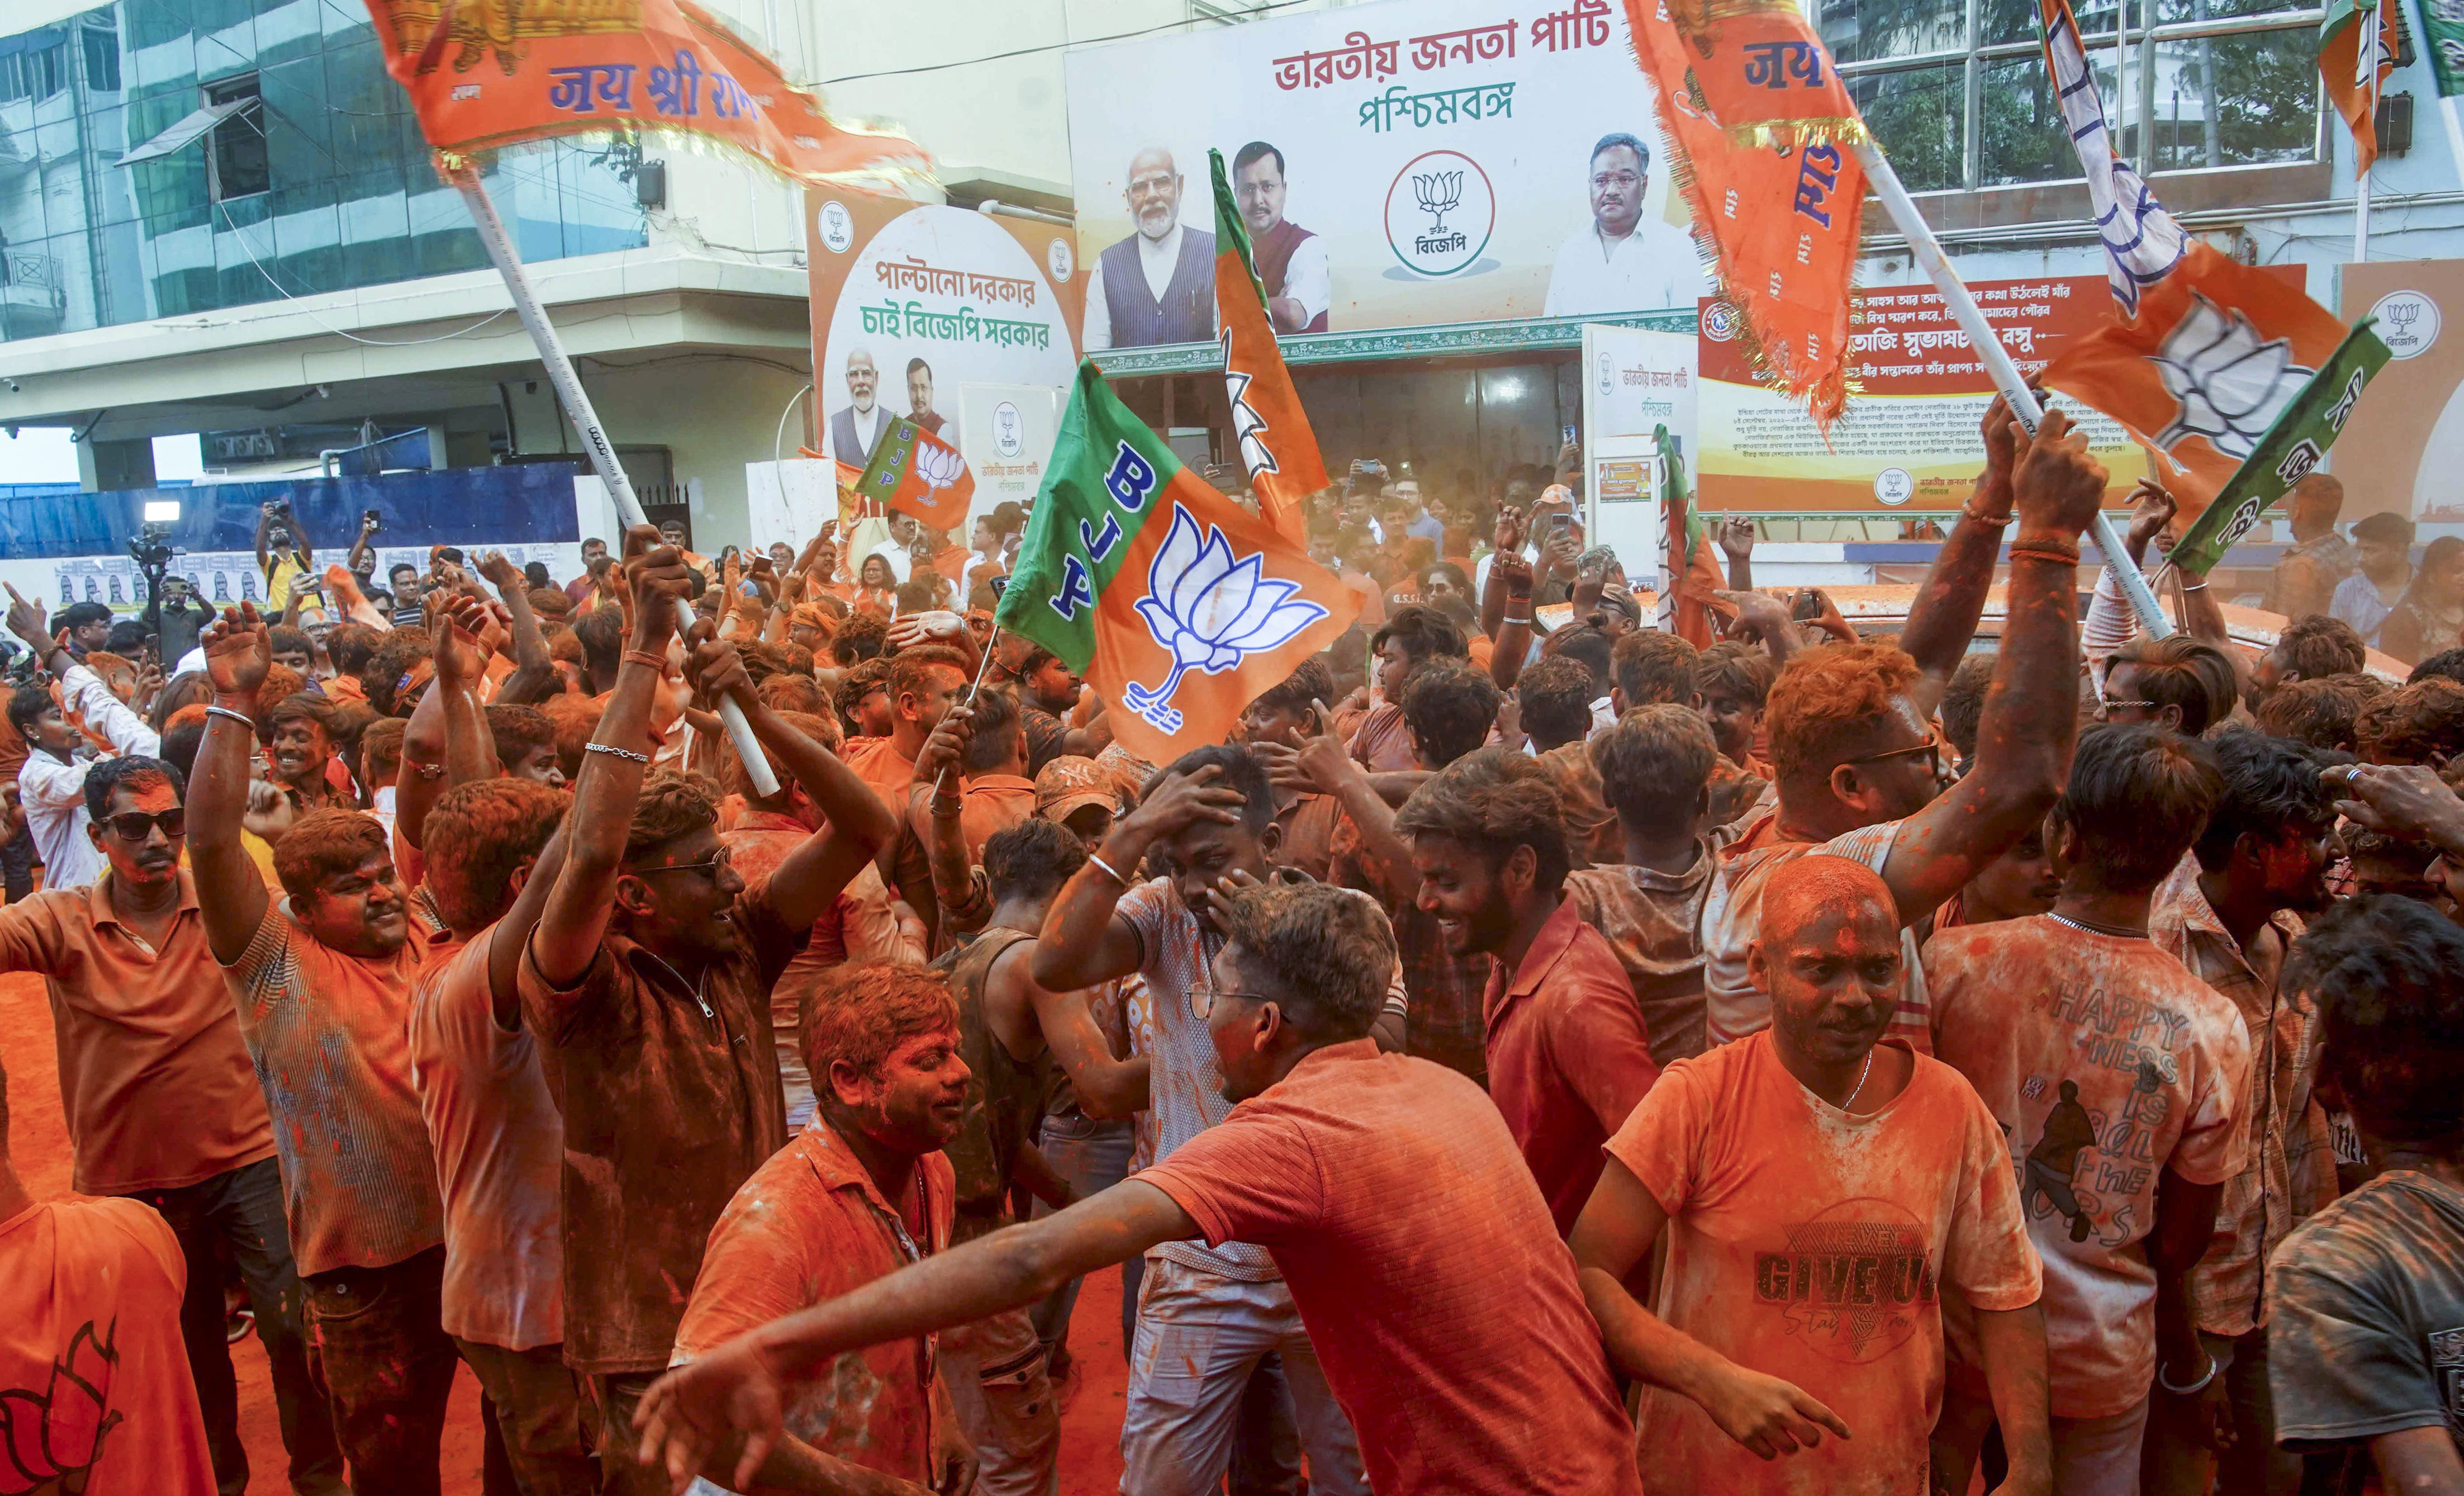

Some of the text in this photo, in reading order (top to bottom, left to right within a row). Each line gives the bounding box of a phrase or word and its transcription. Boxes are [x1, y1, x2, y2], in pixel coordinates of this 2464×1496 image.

[1273, 31, 1400, 91] ভারতীয়
[1408, 18, 1519, 71] জনতা
[1743, 41, 1825, 89] जय
[549, 63, 638, 112] जय
[647, 49, 703, 117] श्री
[1359, 81, 1516, 134] পশ্চিমবঙ্গ
[1414, 232, 1467, 255] বিজেপি
[876, 255, 1036, 309] পাল্টানো দরকার
[1867, 296, 1894, 306] সাহস
[1897, 295, 1919, 306] আর
[1985, 290, 2007, 300] কথা
[2010, 285, 2049, 299] উঠলেই
[2052, 283, 2071, 298] যাঁর
[860, 298, 1050, 352] চাই বিজেপি সরকার
[1867, 310, 1886, 324] বিশ্ব
[1888, 311, 1915, 323] স্মরণ
[1917, 310, 1942, 323] করে,
[2020, 302, 2050, 317] গৌরব
[1847, 326, 1898, 352] তাজি
[2002, 326, 2034, 354] বসু
[2385, 335, 2419, 346] বিজেপি
[1622, 363, 1649, 389] ভারতীয়
[1651, 371, 1672, 387] জনতা
[1862, 362, 1877, 377] বীর
[1880, 364, 1924, 378] সন্তানকে
[1925, 361, 1944, 376] তাঁর
[1947, 363, 1973, 375] প্রাপ্য
[1642, 397, 1672, 418] পশ্চিমবঙ্গ
[981, 462, 1005, 477] ভারতীয়
[1007, 465, 1024, 476] জনতা
[1919, 477, 1945, 486] ভারতীয়
[1048, 438, 1157, 622] BJP
[2050, 979, 2189, 1051] HAPPY
[2123, 1087, 2168, 1125] IS
[1756, 1252, 1879, 1305] GIVE
